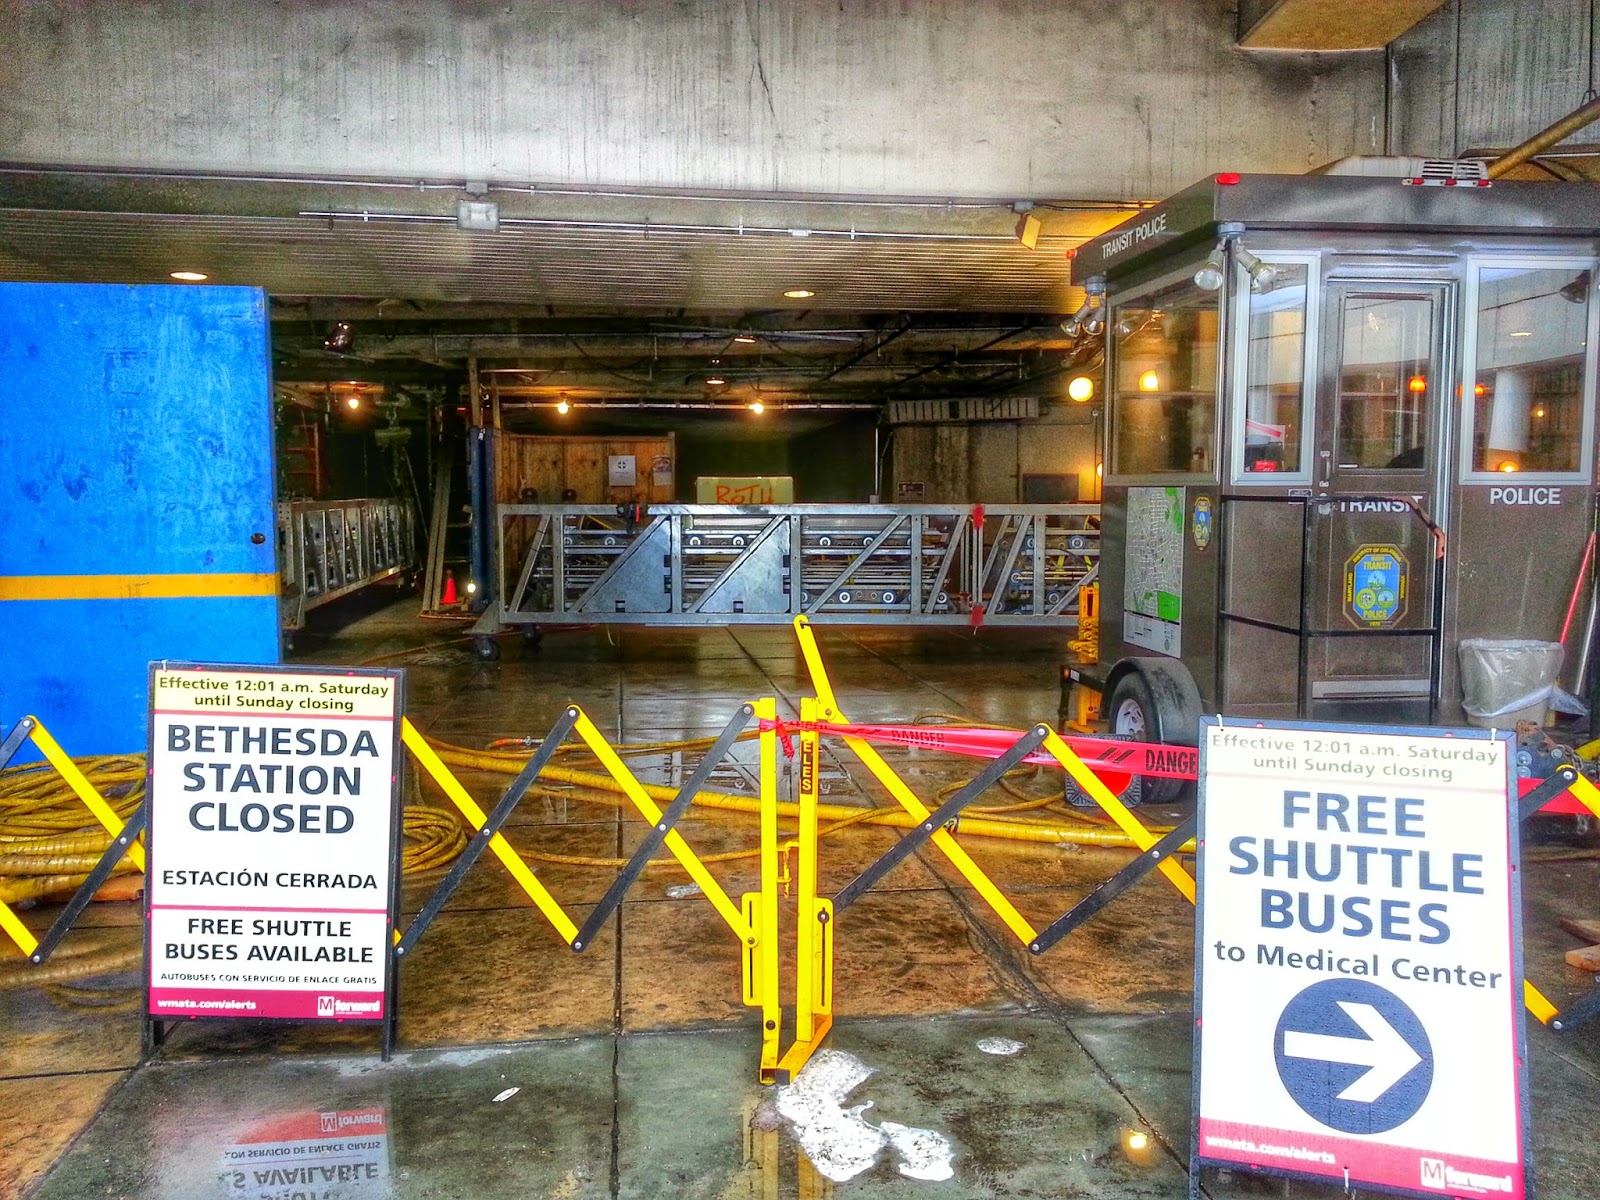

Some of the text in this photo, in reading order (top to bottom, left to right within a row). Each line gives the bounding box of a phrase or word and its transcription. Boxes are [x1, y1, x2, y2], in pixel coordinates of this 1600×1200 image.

[1102, 213, 1167, 259] TRANSIT POLICE
[1489, 487, 1562, 506] POLICE
[159, 676, 389, 698] Effective 12:01 a.m. Saturday
[194, 695, 355, 713] until Sunday closing
[167, 724, 380, 758] BETHESDA
[891, 730, 946, 748] DANGER
[1212, 733, 1499, 766] Effective 12:01 a.m. Saturday
[183, 762, 361, 796] STATION
[1253, 756, 1454, 783] until Sunday closing
[189, 801, 355, 834] CLOSED
[1283, 790, 1426, 838] FREE
[162, 868, 378, 890] ESTACIÓN CERRADA
[1228, 836, 1485, 895] SHUTTLE
[188, 918, 352, 938] FREE SHUTTLE
[1260, 888, 1451, 945] BUSES
[165, 943, 374, 963] BUSES AVAILABLE
[1213, 940, 1502, 989] to Medical Center
[161, 972, 378, 985] AUTOBUSES CON SERVICIO DE ENLACE GRATIS
[157, 999, 257, 1011] wmata.com/alerts
[1205, 1134, 1336, 1164] wmata.com/alerts
